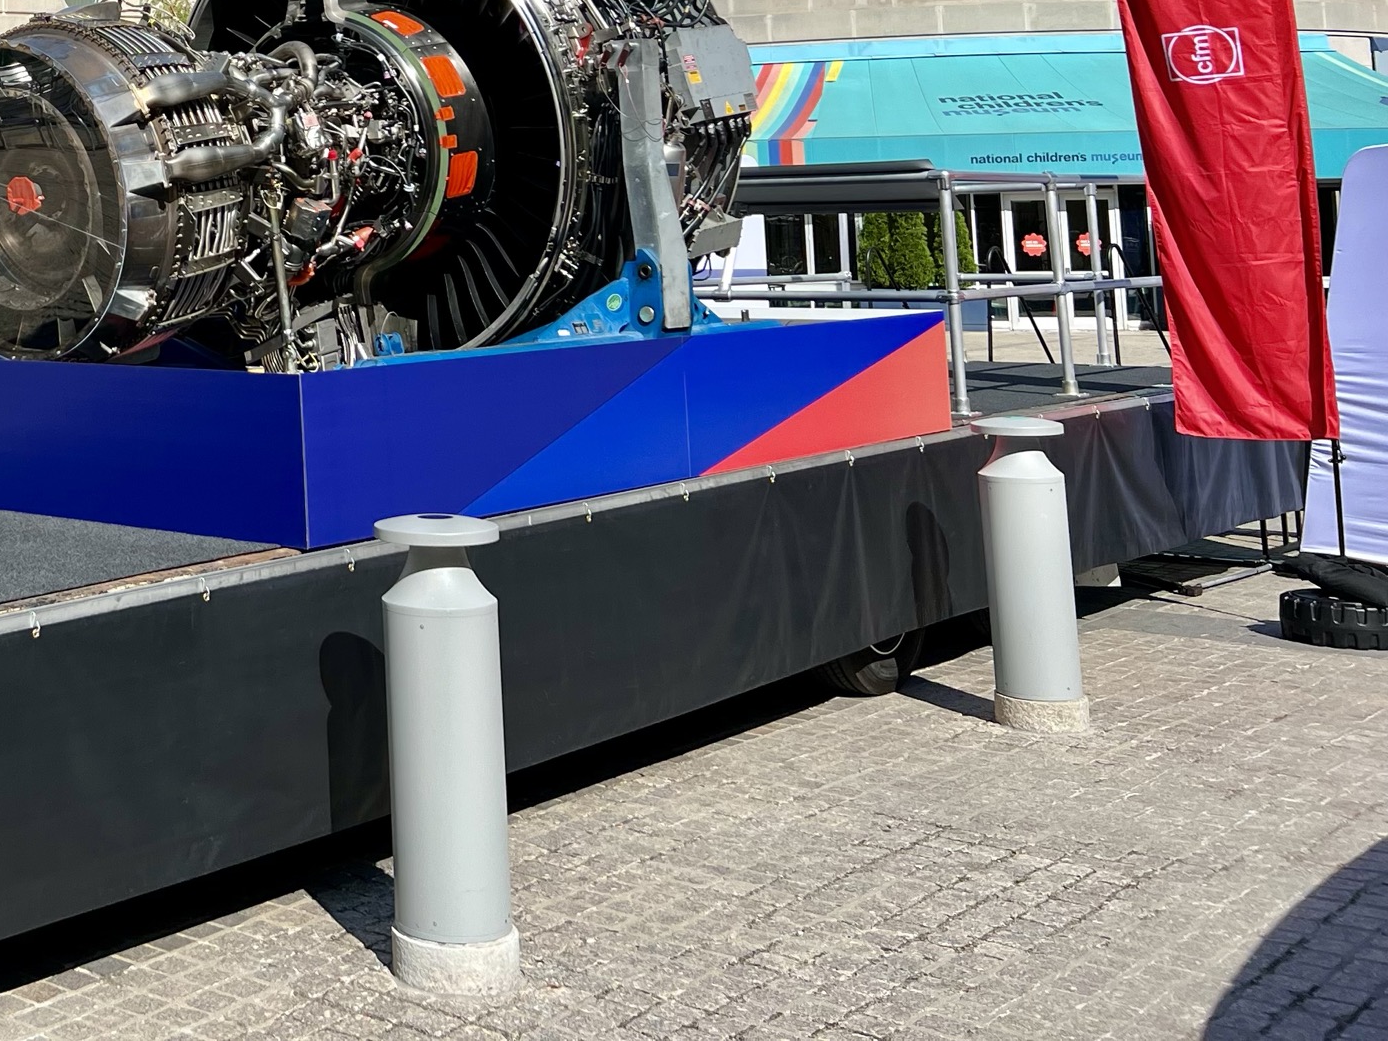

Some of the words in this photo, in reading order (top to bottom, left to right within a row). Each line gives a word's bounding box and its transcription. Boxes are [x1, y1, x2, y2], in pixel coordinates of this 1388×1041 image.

[1190, 35, 1213, 74] cfm
[938, 92, 1064, 104] national
[942, 106, 1082, 116] museum
[970, 153, 1023, 165] national
